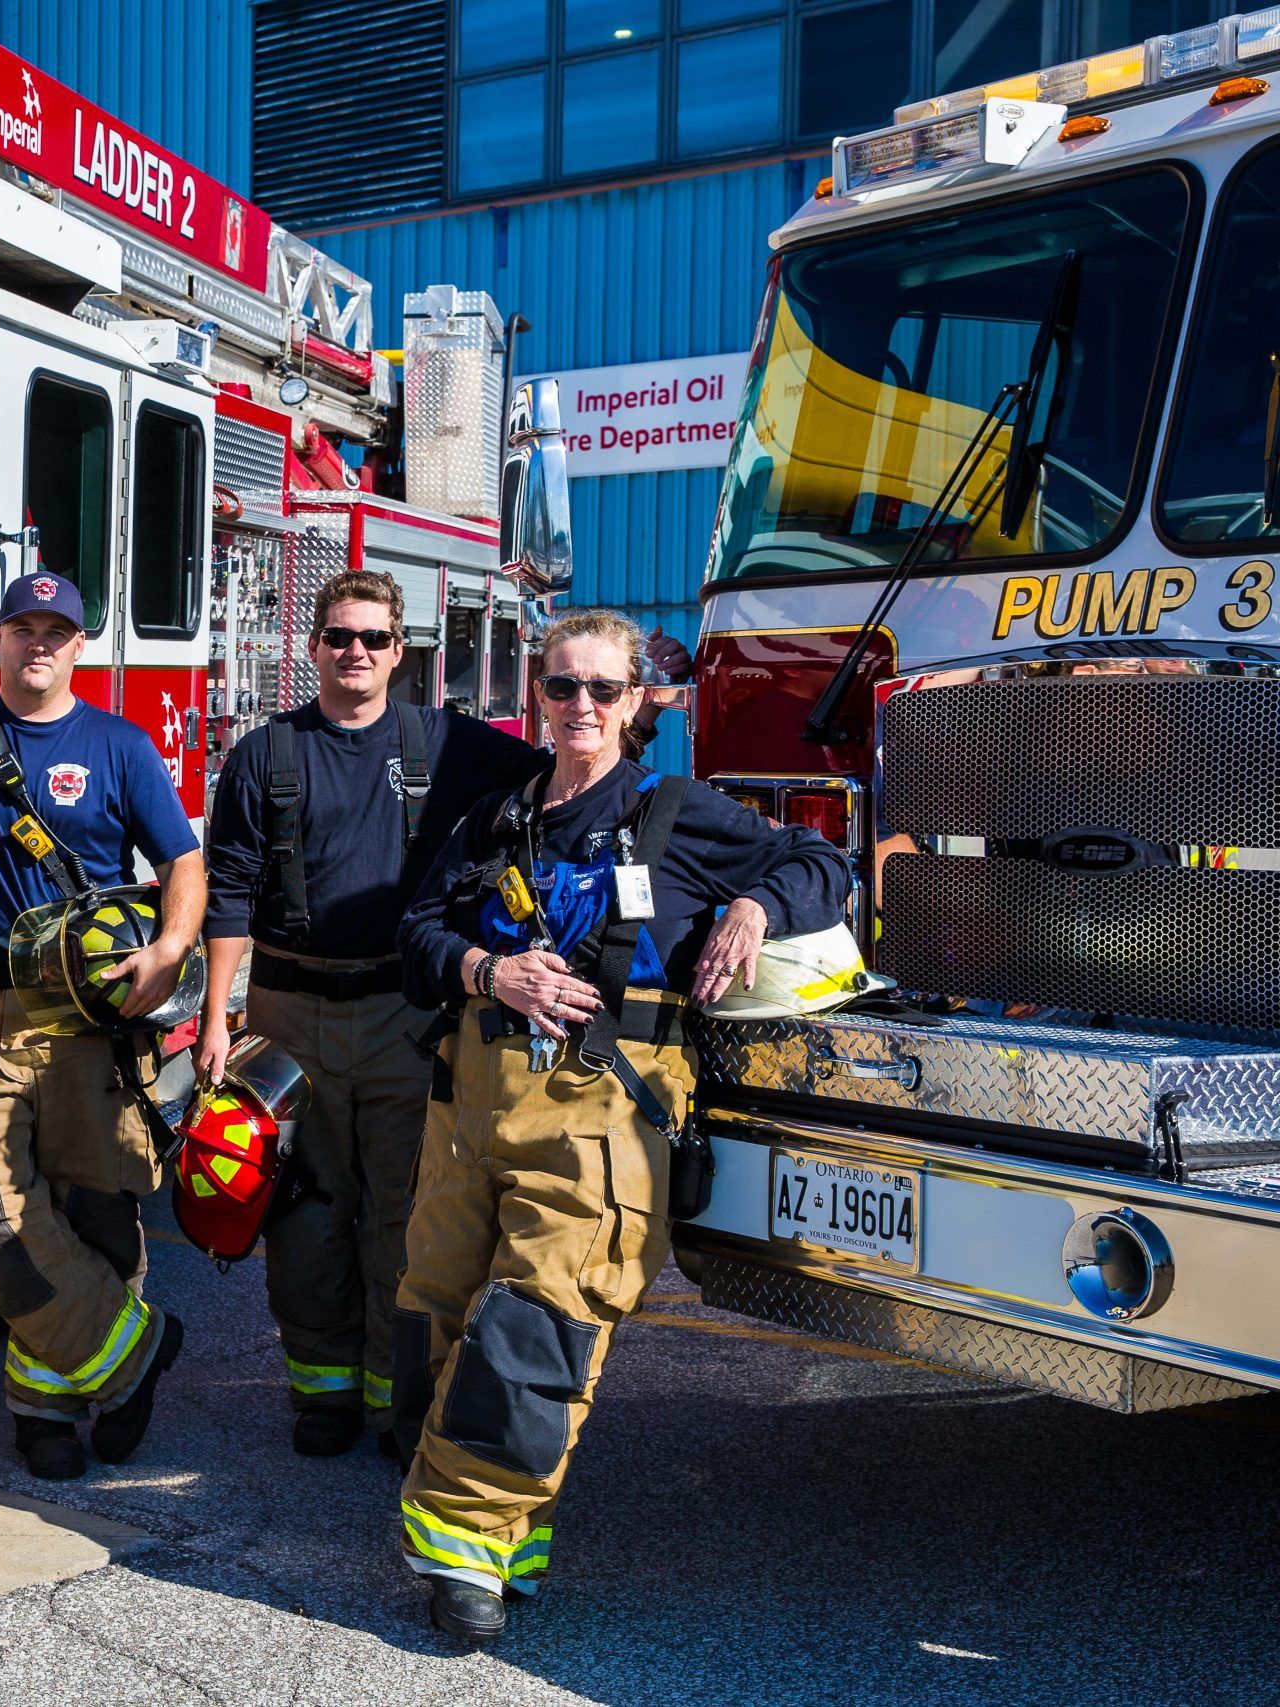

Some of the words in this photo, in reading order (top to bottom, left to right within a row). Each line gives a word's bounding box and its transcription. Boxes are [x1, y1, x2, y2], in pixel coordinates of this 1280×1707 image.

[73, 108, 173, 228] LADDER
[180, 175, 196, 240] 2
[577, 380, 678, 418] Imperial
[686, 374, 724, 402] Oil
[562, 428, 592, 453] ire
[600, 420, 737, 454] Departme
[992, 567, 1196, 640] PUMP
[1219, 560, 1276, 632] 3
[1061, 843, 1126, 861] E-ONE
[815, 1162, 874, 1184] ONTARIO
[777, 1173, 808, 1223] AZ
[828, 1182, 912, 1245] 19604
[809, 1229, 831, 1241] YOURS
[833, 1234, 842, 1243] TO
[843, 1237, 878, 1250] DISCOVER
